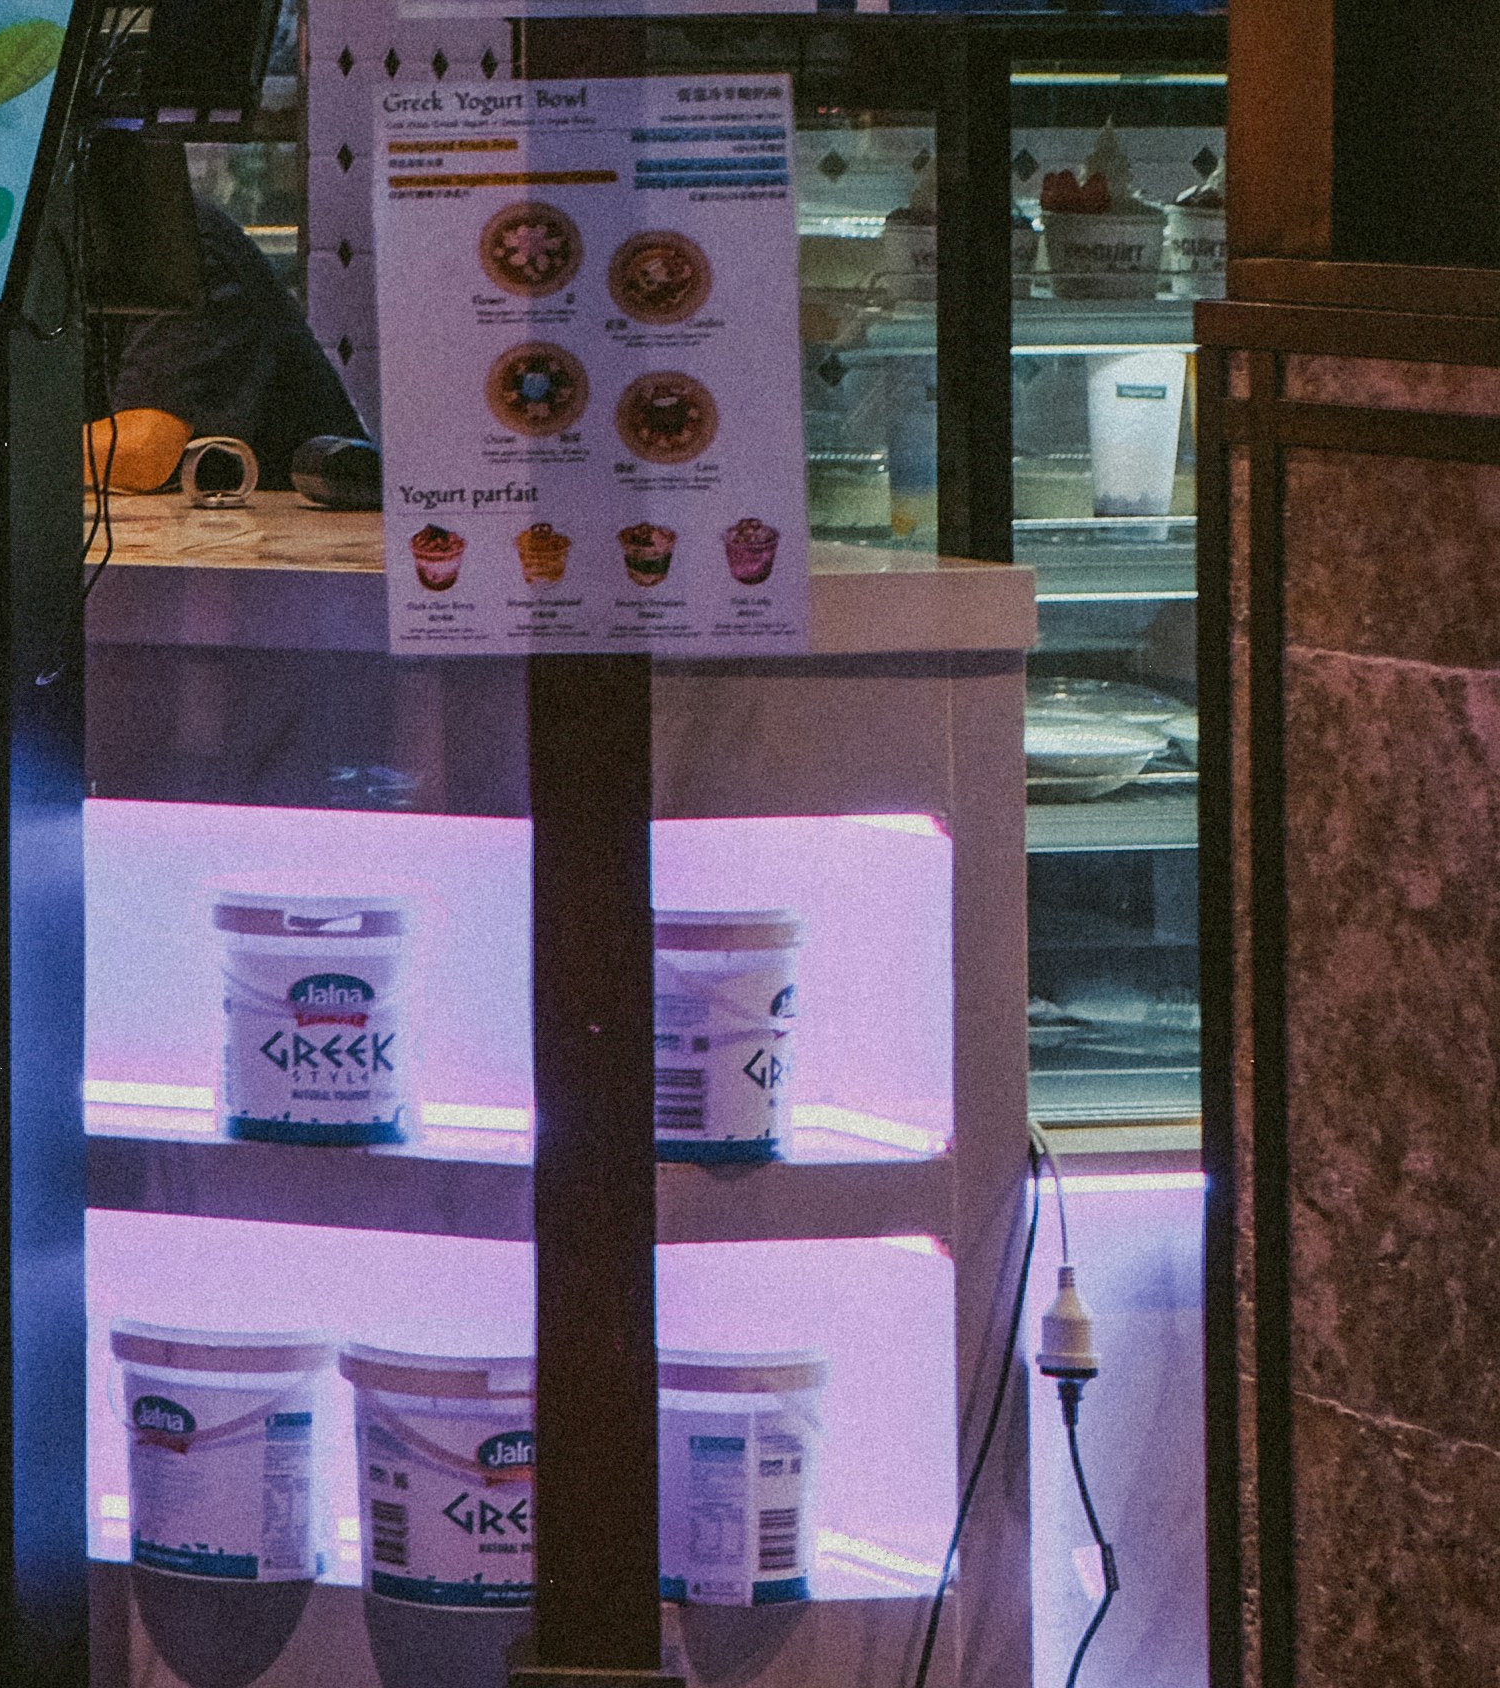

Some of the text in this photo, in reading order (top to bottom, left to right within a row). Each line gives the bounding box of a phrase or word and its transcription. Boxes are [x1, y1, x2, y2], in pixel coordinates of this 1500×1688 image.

[383, 87, 587, 116] Greek Yogurt Bowl
[400, 483, 539, 508] Yogurt parfait
[260, 1031, 396, 1072] GREEK
[442, 1492, 533, 1535] GRE
